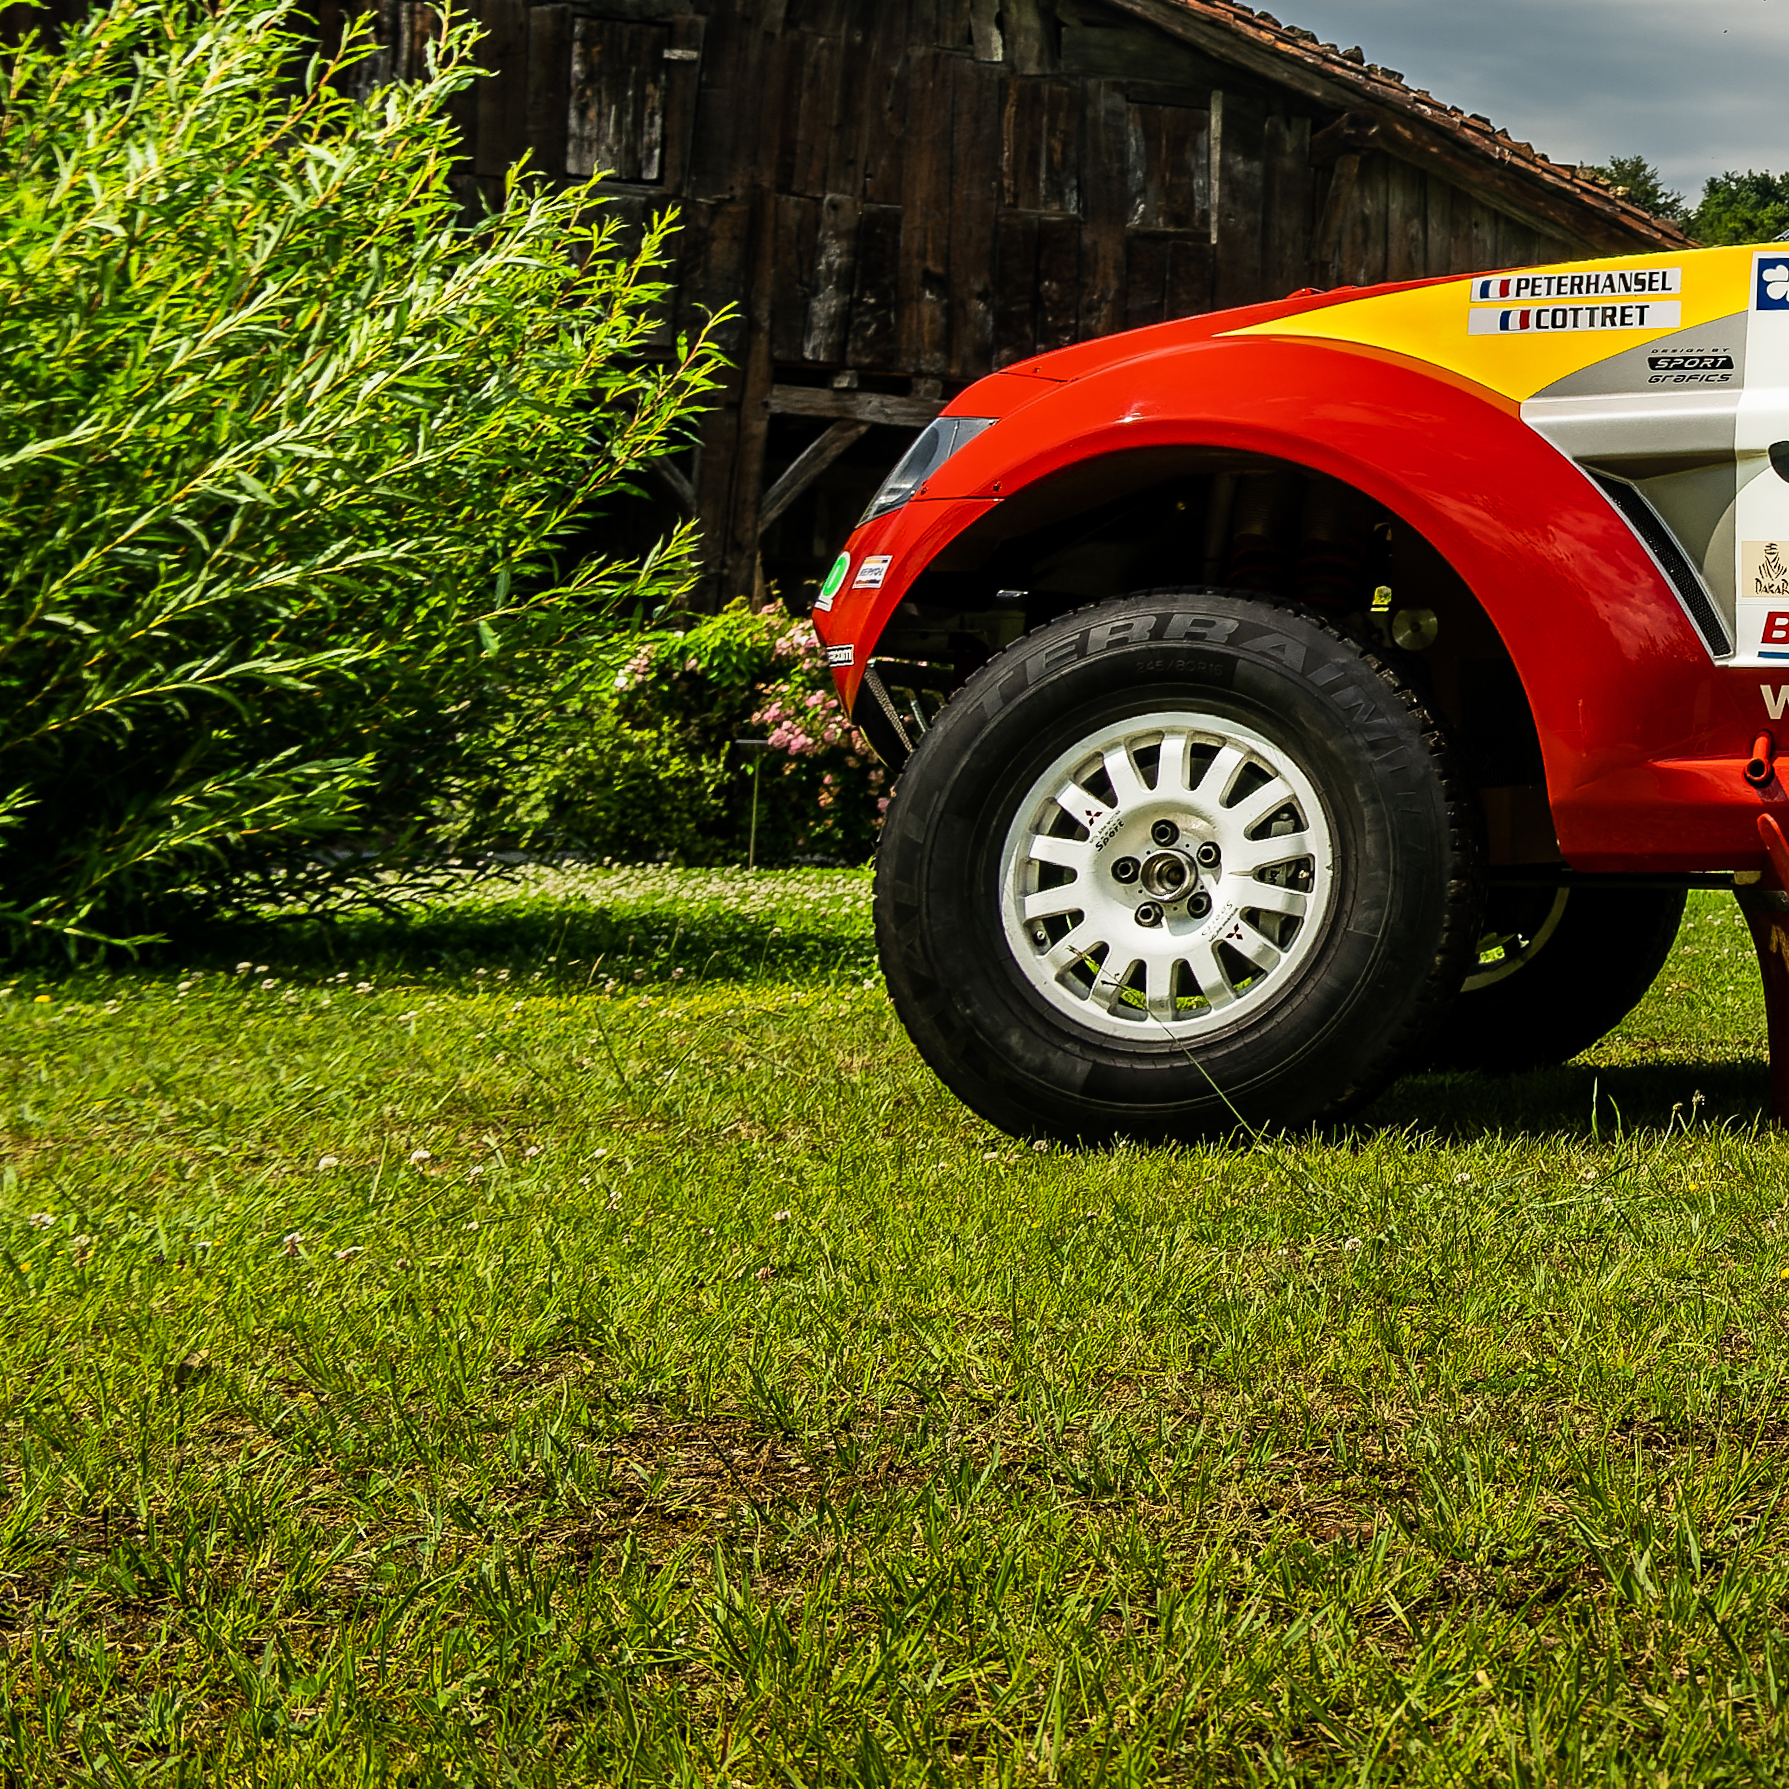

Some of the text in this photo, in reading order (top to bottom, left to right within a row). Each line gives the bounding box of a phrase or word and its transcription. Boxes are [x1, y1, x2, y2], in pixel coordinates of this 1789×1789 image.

[1515, 270, 1673, 298] PETERHANSEL
[1535, 305, 1649, 330] COTTRET
[1655, 357, 1728, 369] SPORT
